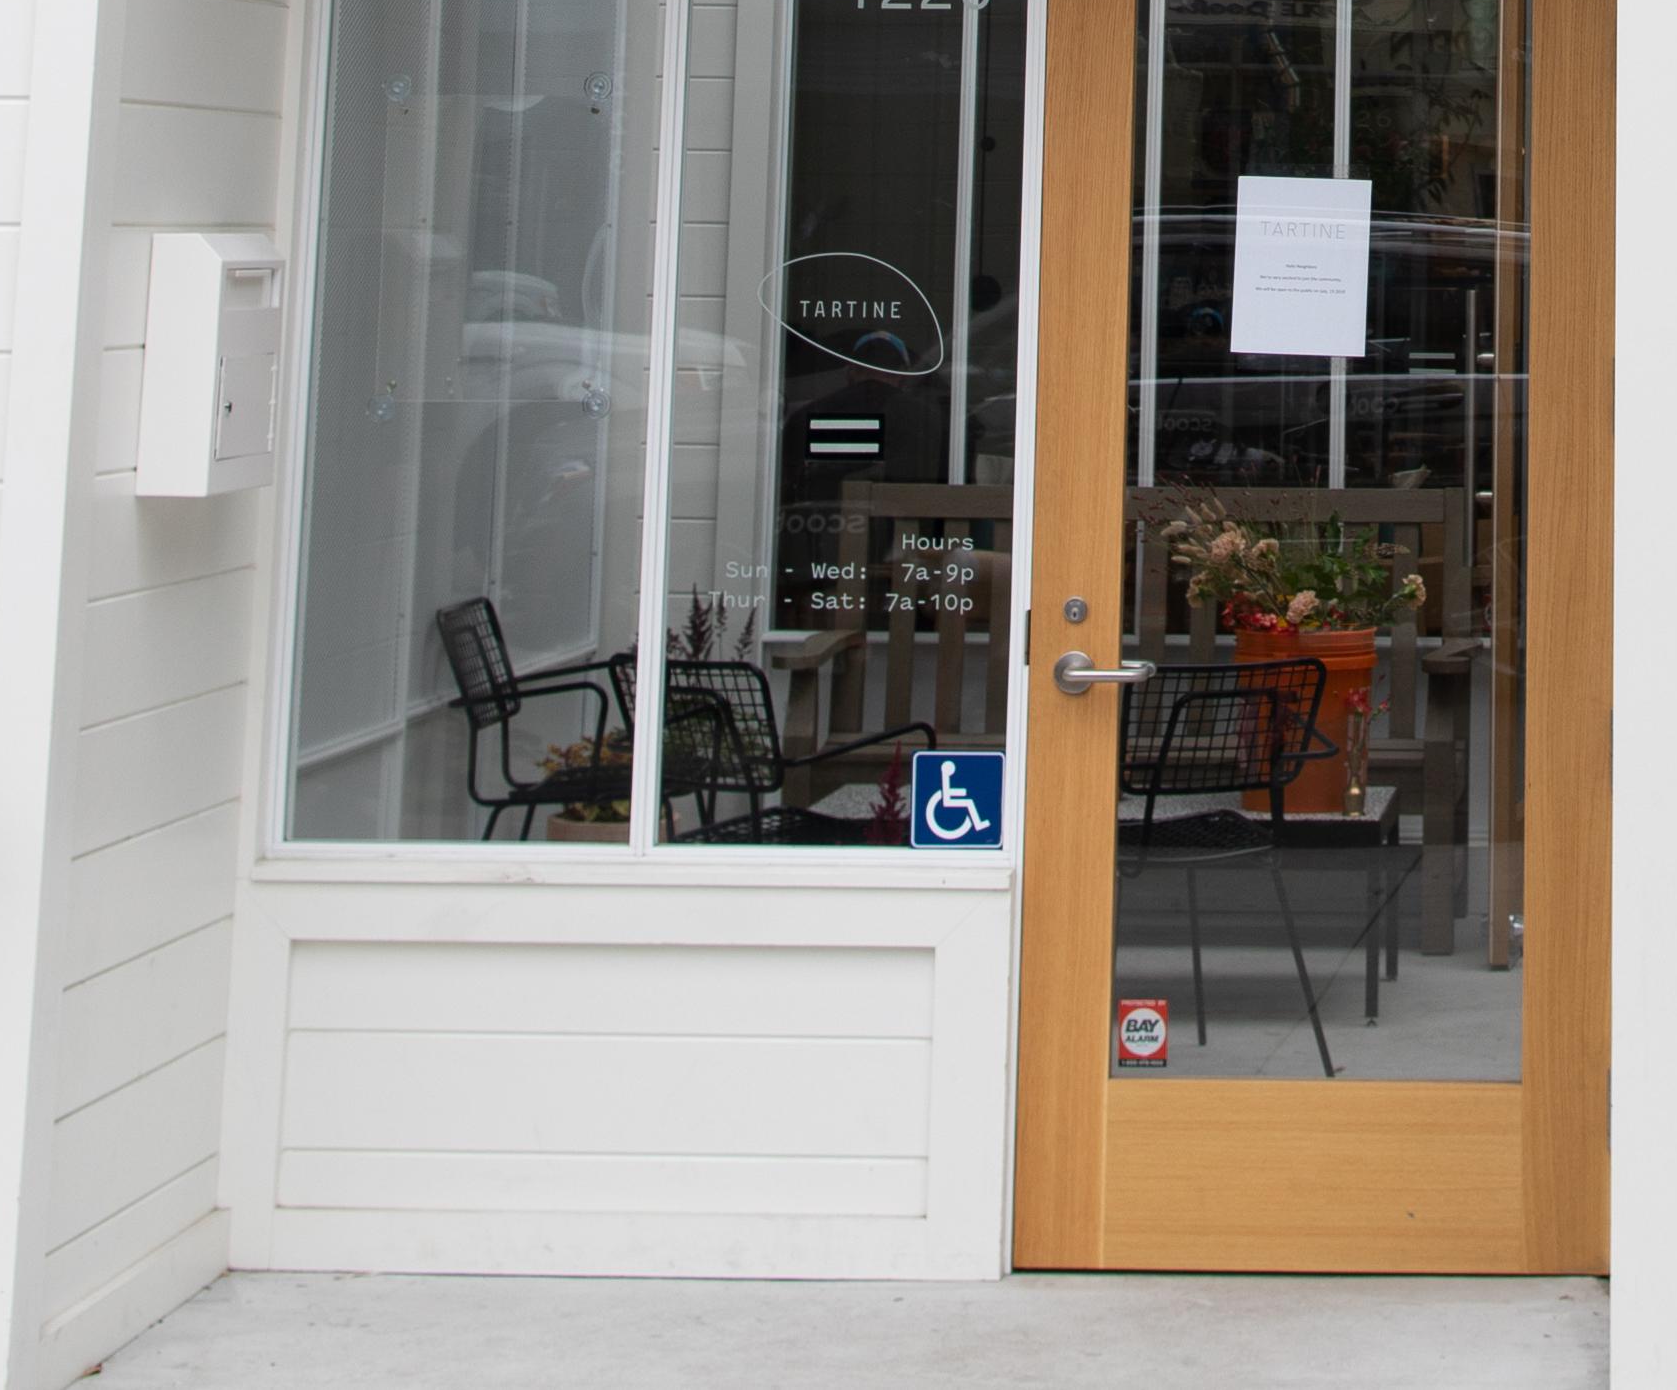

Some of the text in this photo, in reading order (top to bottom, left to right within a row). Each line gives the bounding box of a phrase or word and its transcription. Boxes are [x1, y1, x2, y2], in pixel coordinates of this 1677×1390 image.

[1260, 220, 1346, 240] TARTINE
[799, 300, 902, 319] TARTINE
[901, 533, 974, 551] Hours
[725, 561, 768, 579] Sun
[811, 562, 867, 580] Wed:
[901, 564, 974, 585] 7a-9p
[708, 590, 765, 609] Thur
[810, 591, 866, 610] Sat:
[885, 593, 974, 616] 7a-10p
[1126, 1019, 1160, 1033] BAY
